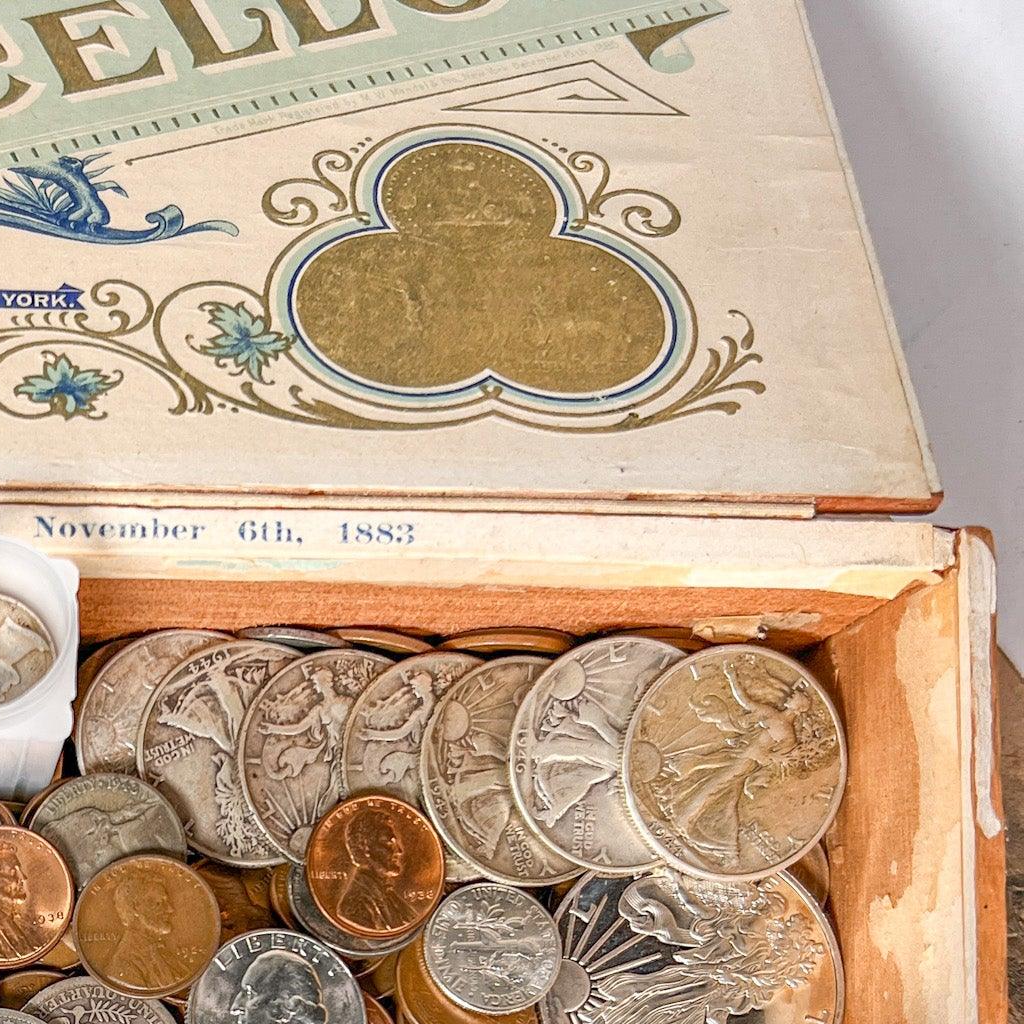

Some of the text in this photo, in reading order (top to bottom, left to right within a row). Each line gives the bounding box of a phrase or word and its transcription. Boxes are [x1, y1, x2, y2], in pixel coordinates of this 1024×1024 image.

[0, 290, 78, 310] YORK.
[33, 515, 206, 541] November
[237, 518, 305, 546] 6th,
[338, 520, 416, 546] 1883
[32, 910, 65, 926] 938
[214, 932, 349, 977] LIBERTY
